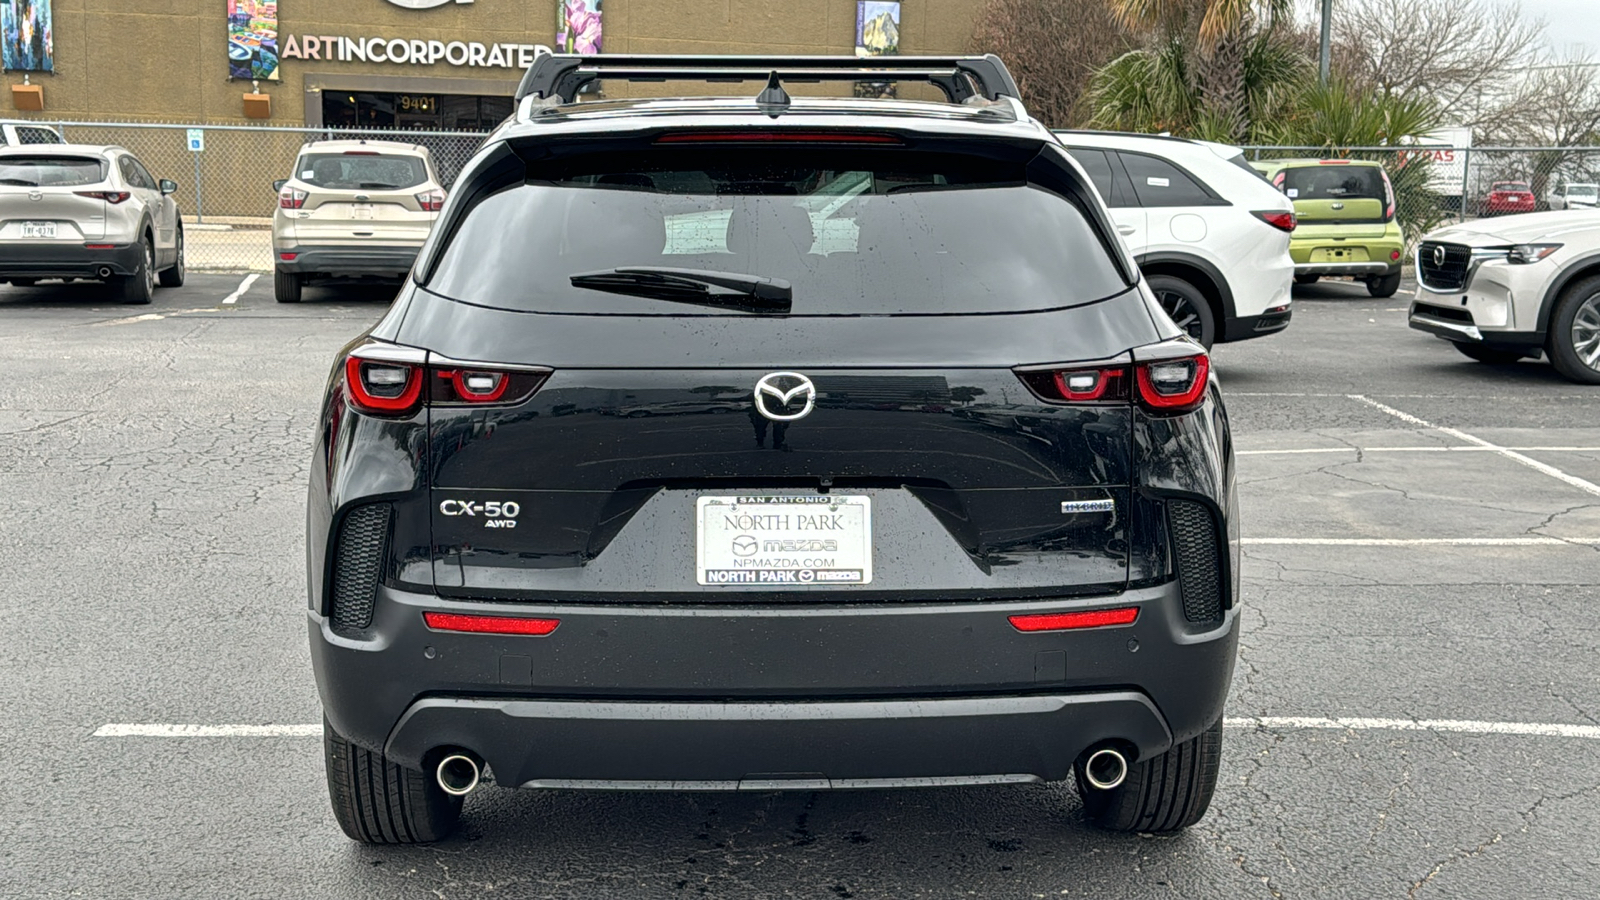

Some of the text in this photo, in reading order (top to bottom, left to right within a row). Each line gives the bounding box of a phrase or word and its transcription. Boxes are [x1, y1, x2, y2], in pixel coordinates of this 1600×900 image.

[401, 95, 436, 112] 9401
[439, 499, 520, 518] CX-50
[484, 519, 517, 528] AWD
[724, 514, 844, 531] NORTH PARK
[733, 558, 835, 568] NPMAZDA.COM
[708, 571, 756, 582] NORTH
[759, 570, 796, 582] PARK
